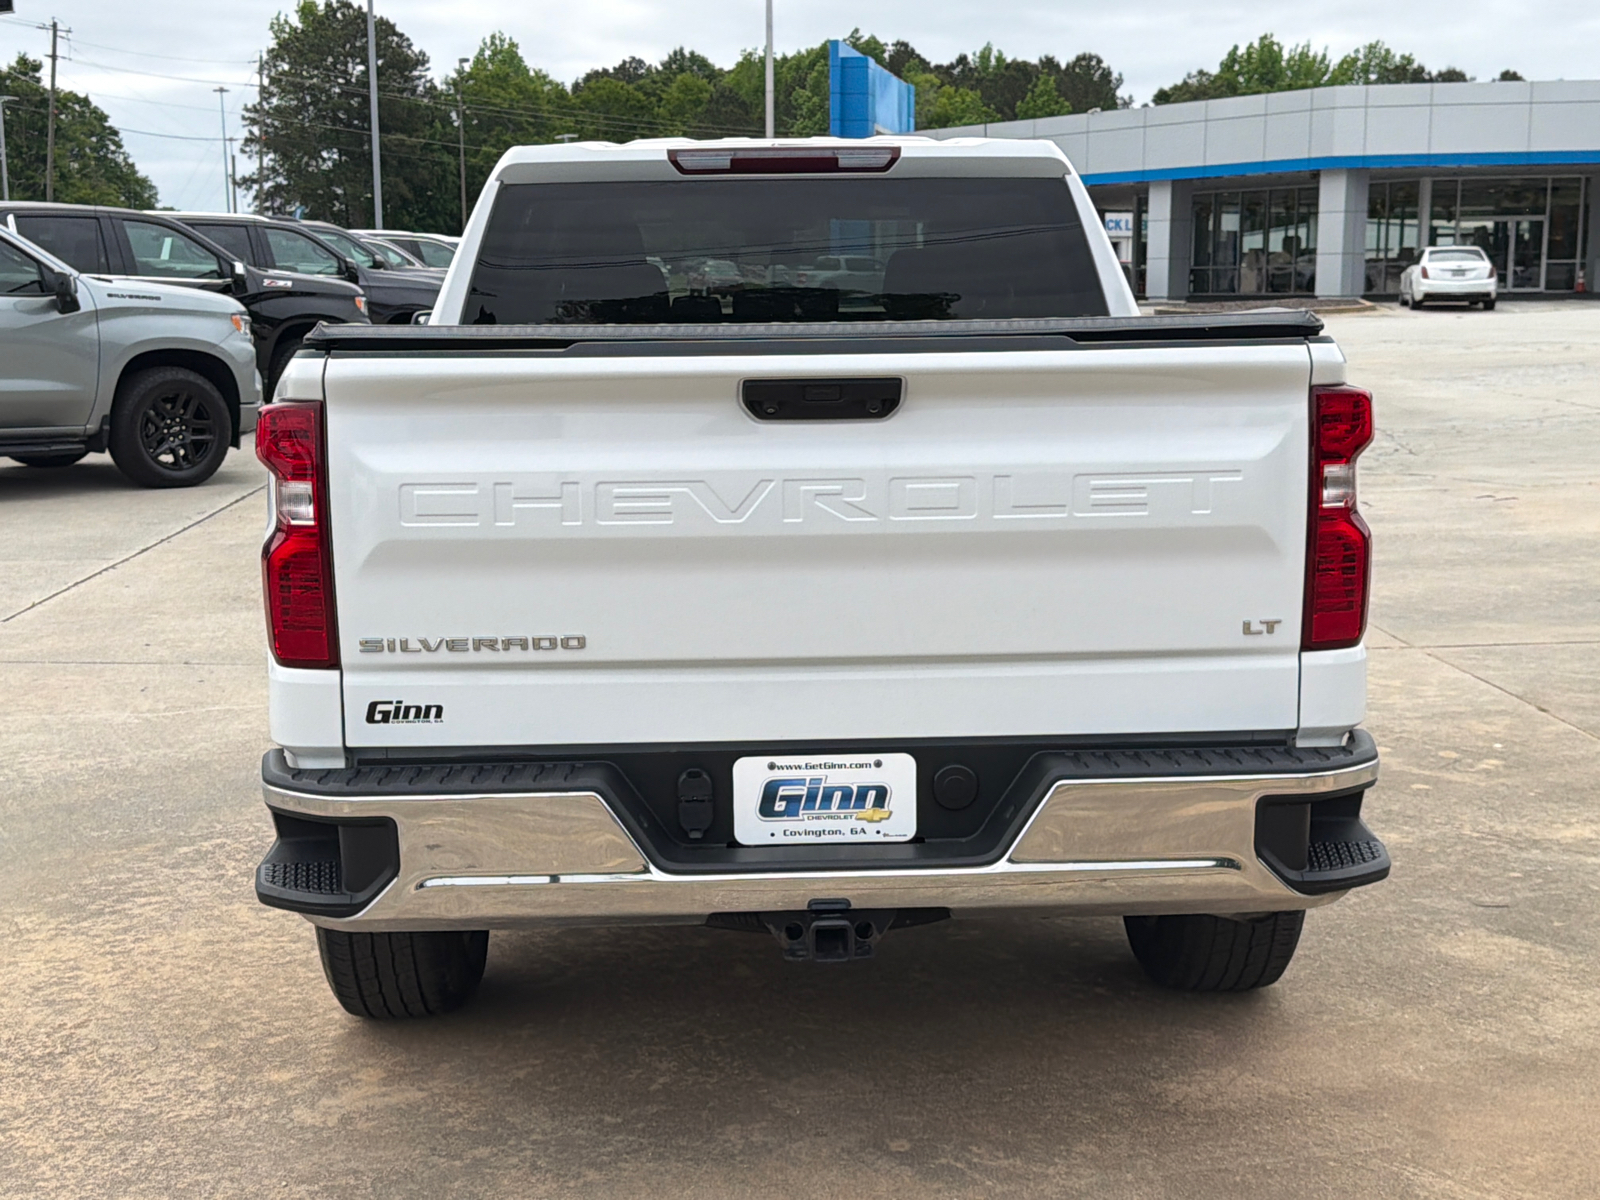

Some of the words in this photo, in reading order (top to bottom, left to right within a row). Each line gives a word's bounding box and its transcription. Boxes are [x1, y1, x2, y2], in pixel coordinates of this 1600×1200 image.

[398, 469, 1244, 526] CHEVROLET
[1242, 619, 1282, 635] LT
[359, 634, 587, 652] SILVERADO
[365, 700, 444, 724] Ginn
[757, 777, 890, 819] Ginn
[783, 829, 846, 838] Covington,
[850, 828, 867, 836] GA
